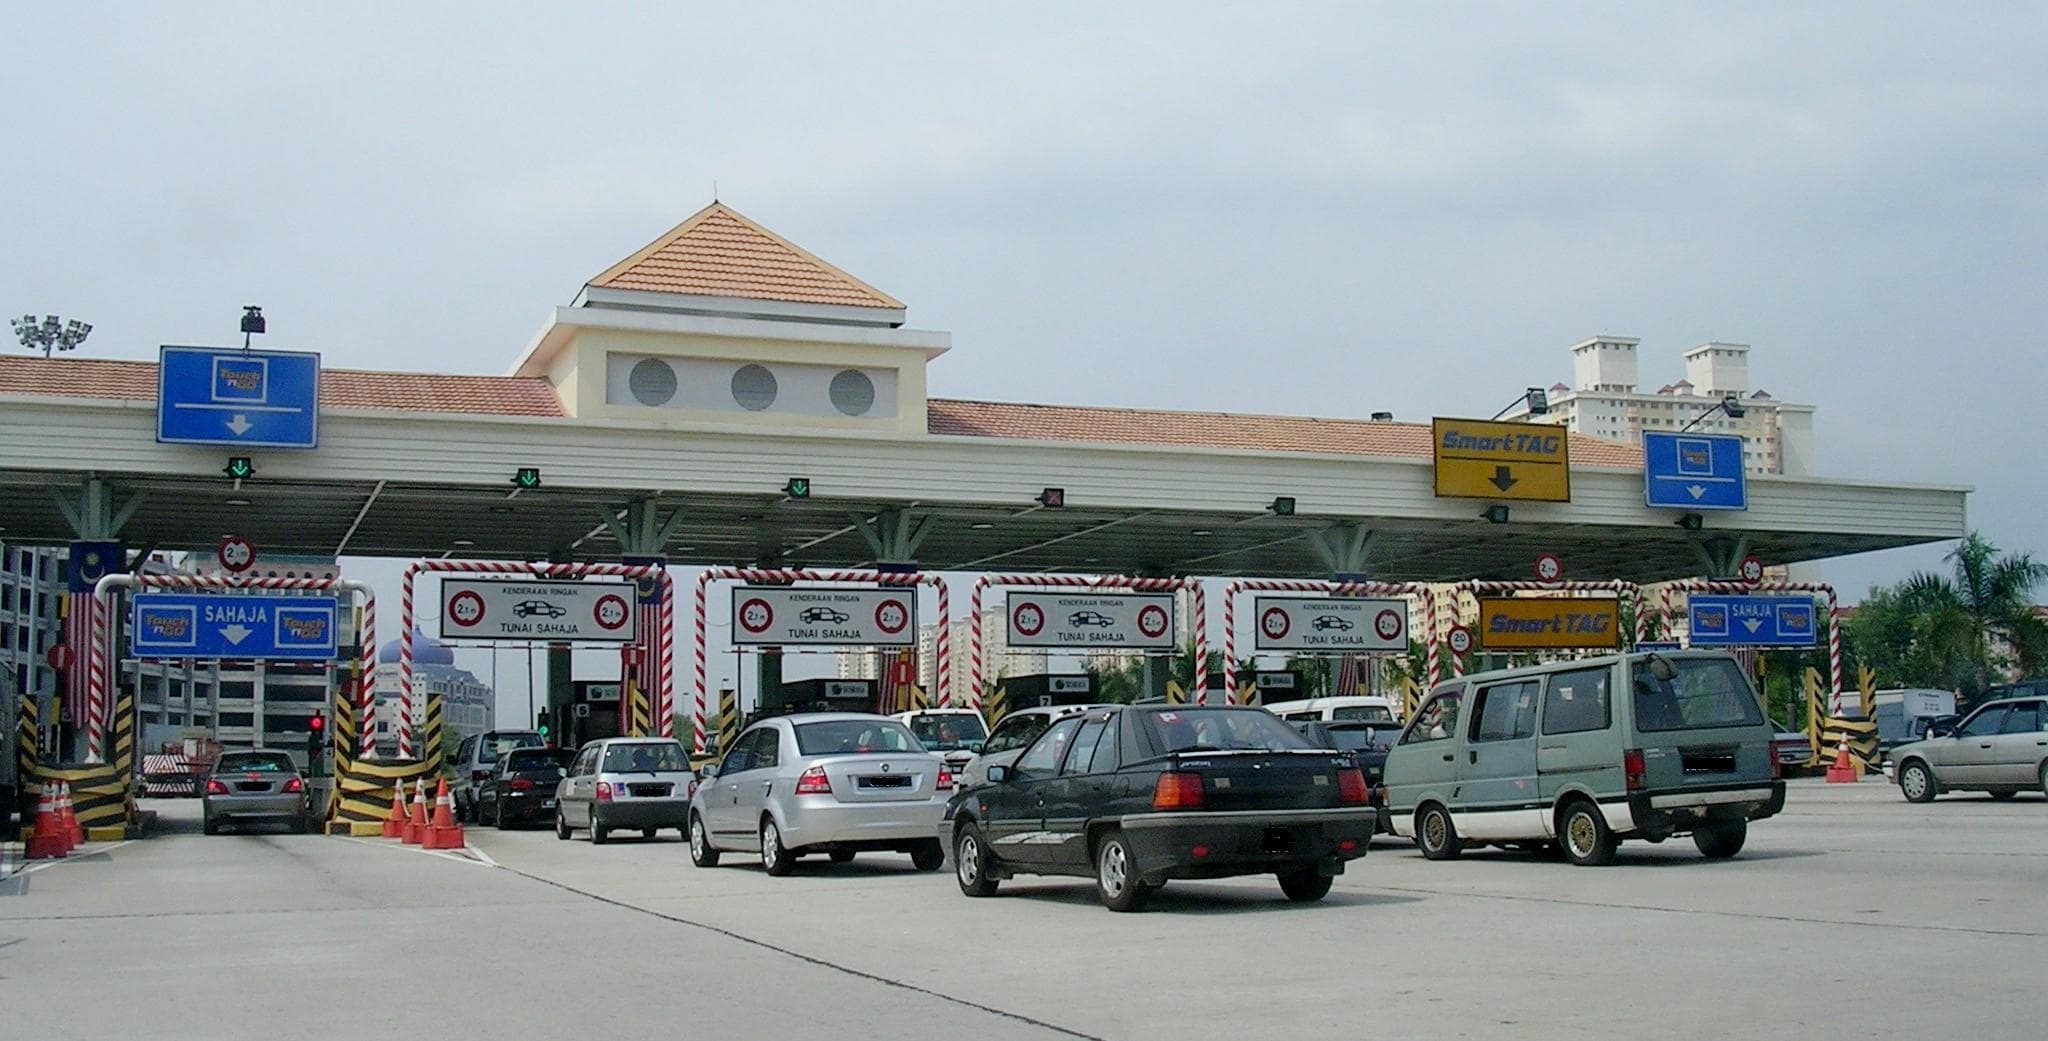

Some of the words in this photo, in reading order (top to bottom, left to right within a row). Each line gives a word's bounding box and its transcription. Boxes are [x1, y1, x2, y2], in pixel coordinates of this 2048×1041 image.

[205, 605, 267, 623] SAHAJA
[1731, 604, 1773, 617] SAHAJA
[1489, 612, 1610, 634] SmartTAG
[500, 623, 532, 633] TUNAI
[537, 624, 578, 634] SAHAJA
[789, 629, 818, 638] TUNAI
[822, 629, 861, 639] SAHAJA
[1057, 633, 1085, 641] TUNAI
[1089, 633, 1125, 642] SAHAJA
[1454, 633, 1466, 642] 20
[1303, 635, 1329, 643] TUNAI
[1331, 636, 1364, 644] SAHAJA
[1042, 697, 1049, 706] 7
